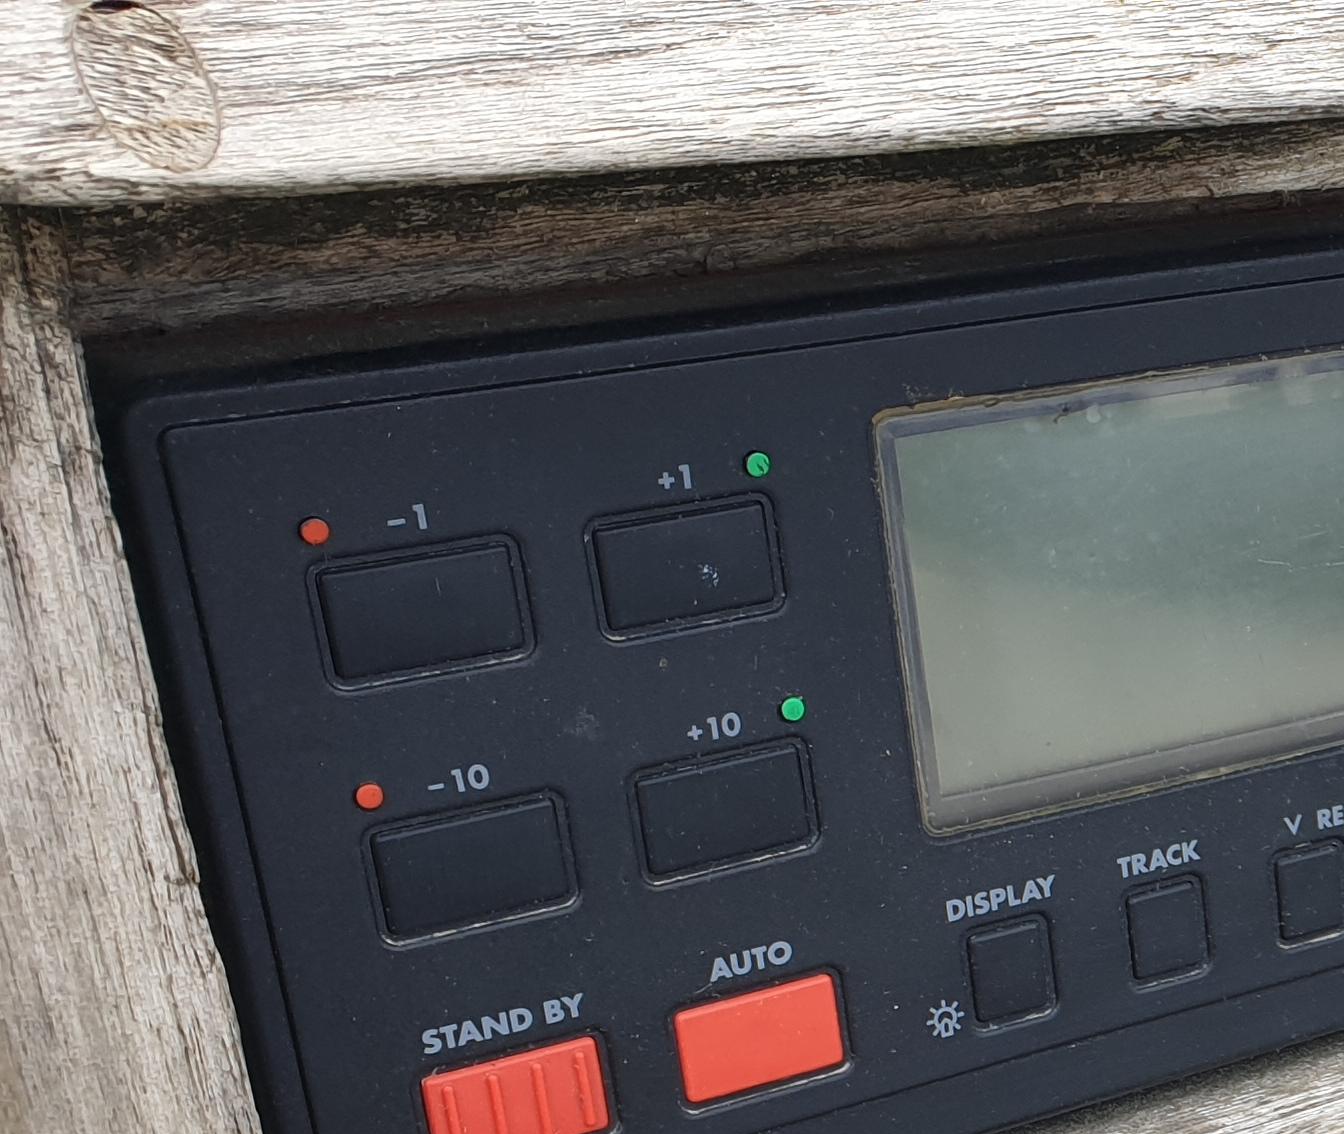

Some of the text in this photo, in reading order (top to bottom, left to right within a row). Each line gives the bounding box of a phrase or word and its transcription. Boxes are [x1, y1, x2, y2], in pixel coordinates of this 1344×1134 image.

[657, 464, 693, 490] +1
[387, 504, 428, 530] -1
[686, 712, 742, 742] +10
[427, 763, 491, 793] -10
[1117, 839, 1201, 879] TRACK
[945, 875, 1057, 923] DISPLAY
[709, 941, 793, 983] AUTO
[421, 993, 584, 1055] STAND BY
